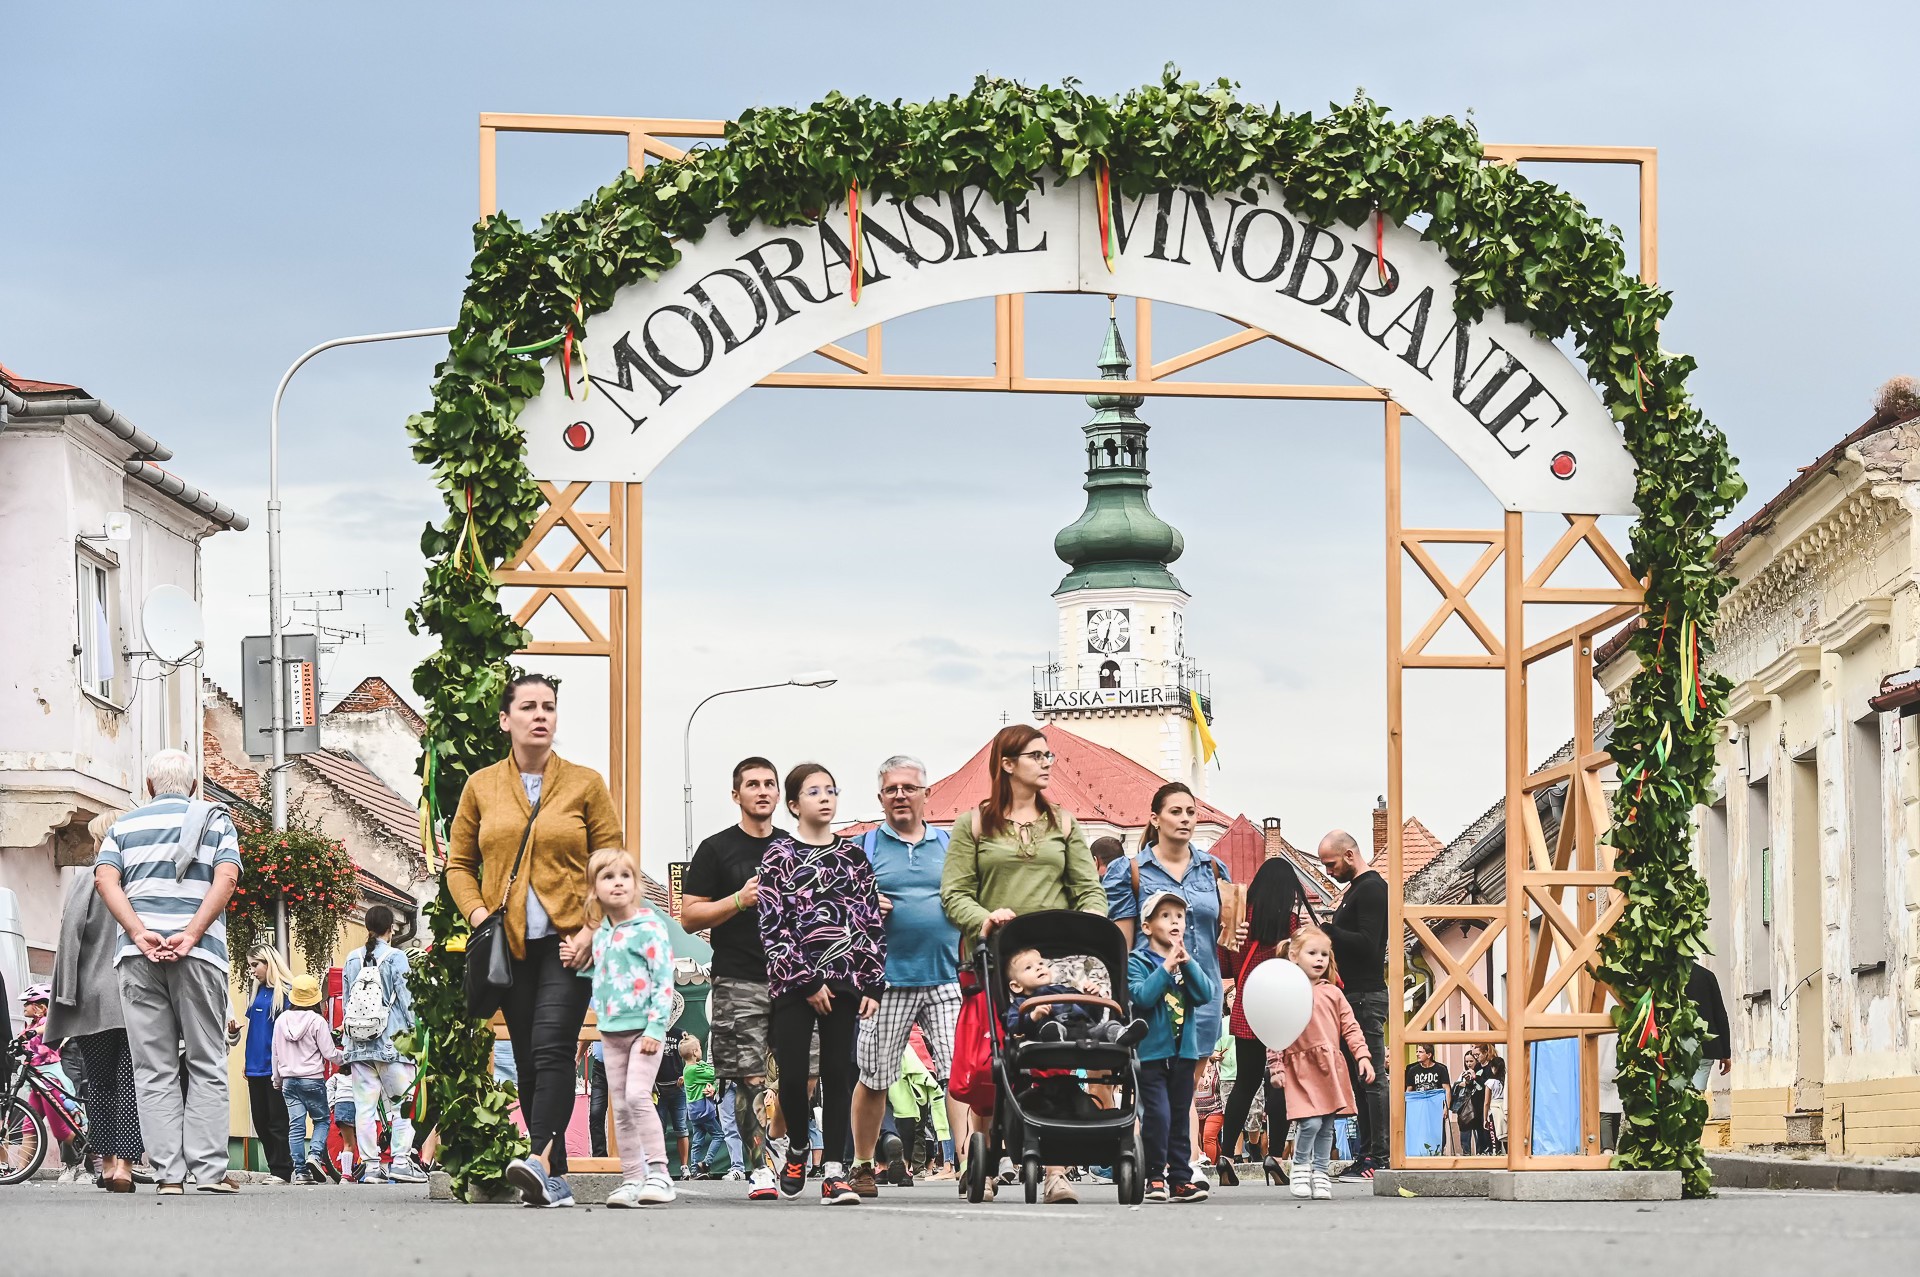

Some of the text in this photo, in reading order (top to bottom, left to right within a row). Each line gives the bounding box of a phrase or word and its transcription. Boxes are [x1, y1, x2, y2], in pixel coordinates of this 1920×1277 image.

[1110, 185, 1568, 459] VINOBRANIE
[1044, 690, 1104, 707] LÁSKA
[1118, 687, 1164, 704] MIER
[671, 864, 683, 924] ŽELEZIARSTV
